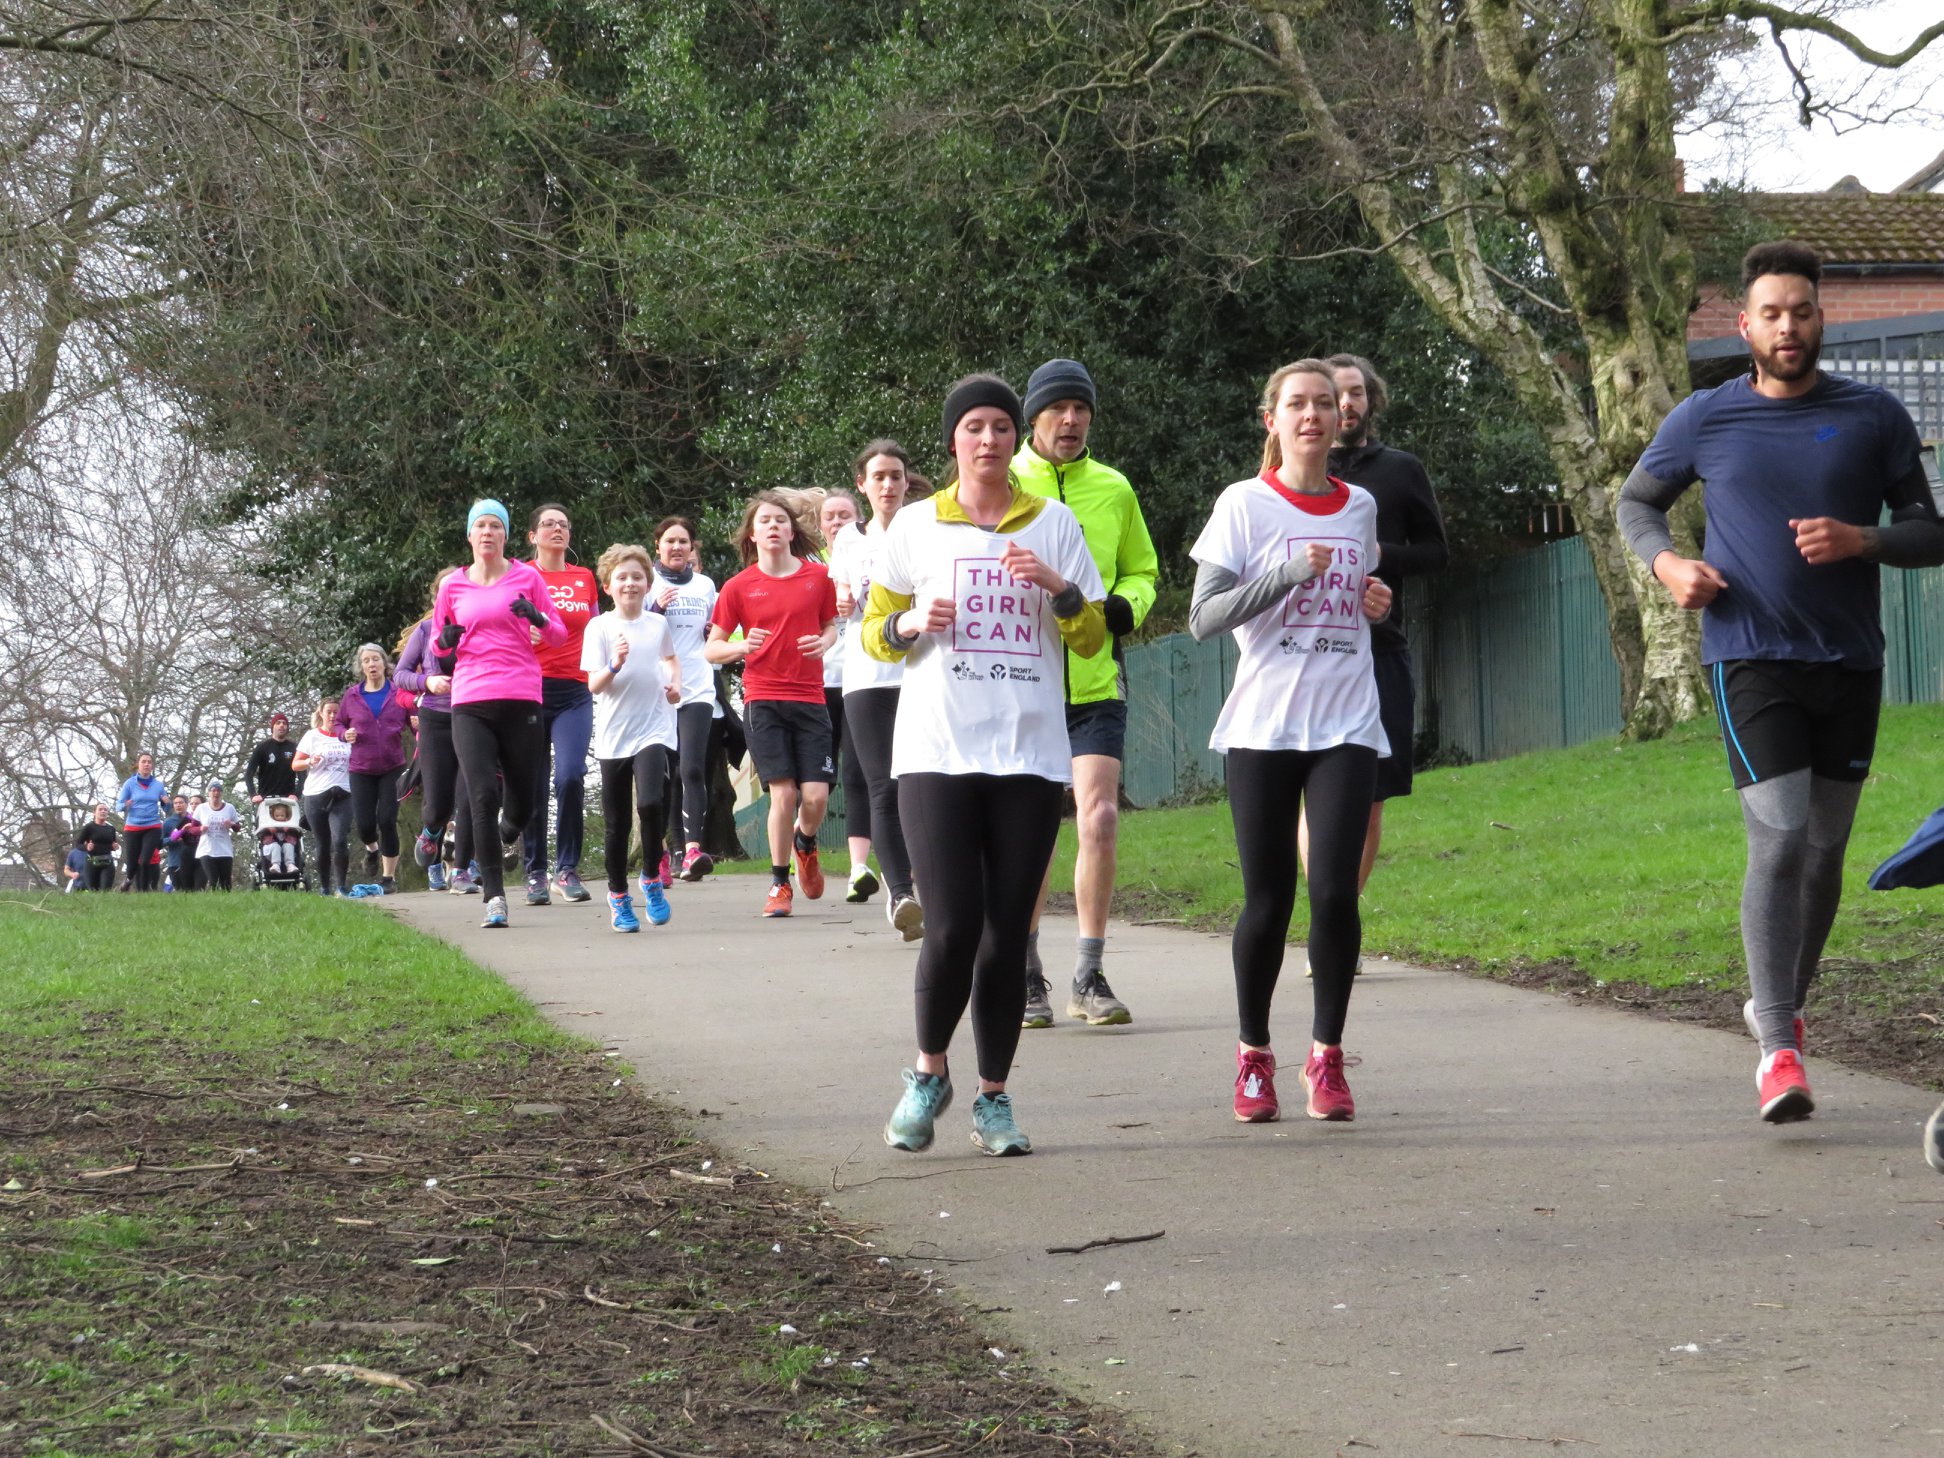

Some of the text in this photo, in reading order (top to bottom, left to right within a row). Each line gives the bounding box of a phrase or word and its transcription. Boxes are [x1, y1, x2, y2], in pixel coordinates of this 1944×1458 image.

[966, 595, 1030, 616] GIRL
[1296, 598, 1354, 617] CAN
[966, 621, 1031, 643] CAN
[1009, 666, 1032, 674] SPORT
[1009, 673, 1040, 682] ENGLAND
